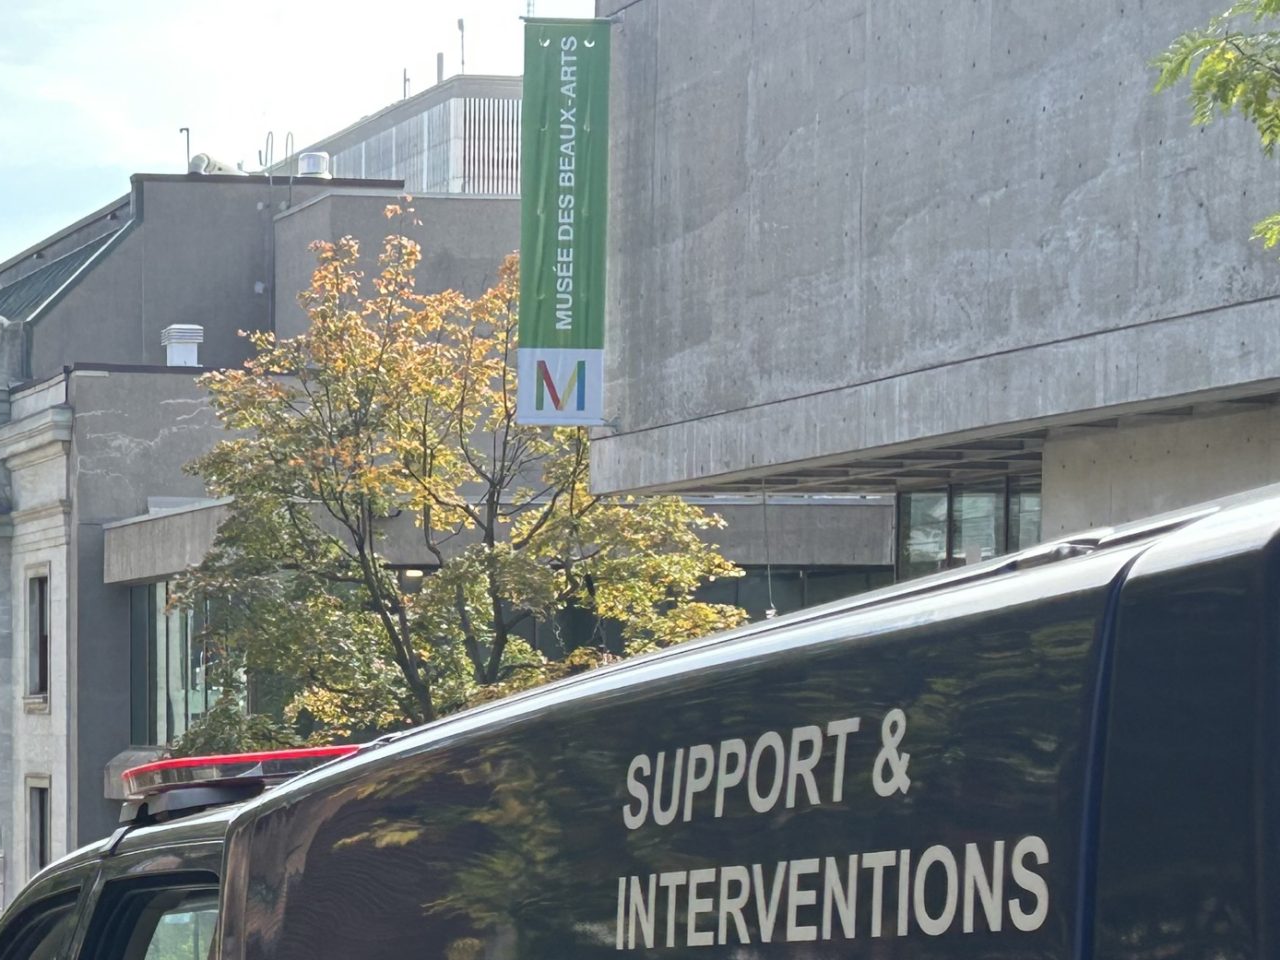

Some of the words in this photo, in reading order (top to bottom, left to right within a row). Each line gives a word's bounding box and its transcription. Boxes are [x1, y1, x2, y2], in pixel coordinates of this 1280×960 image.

[559, 35, 578, 187] BEAUX-ARTS
[558, 194, 575, 240] DES
[552, 247, 574, 331] MUSÉE
[535, 359, 586, 411] M
[622, 716, 861, 830] SUPPORT
[871, 707, 912, 798] &
[615, 835, 1051, 951] INTERVENTIONS
